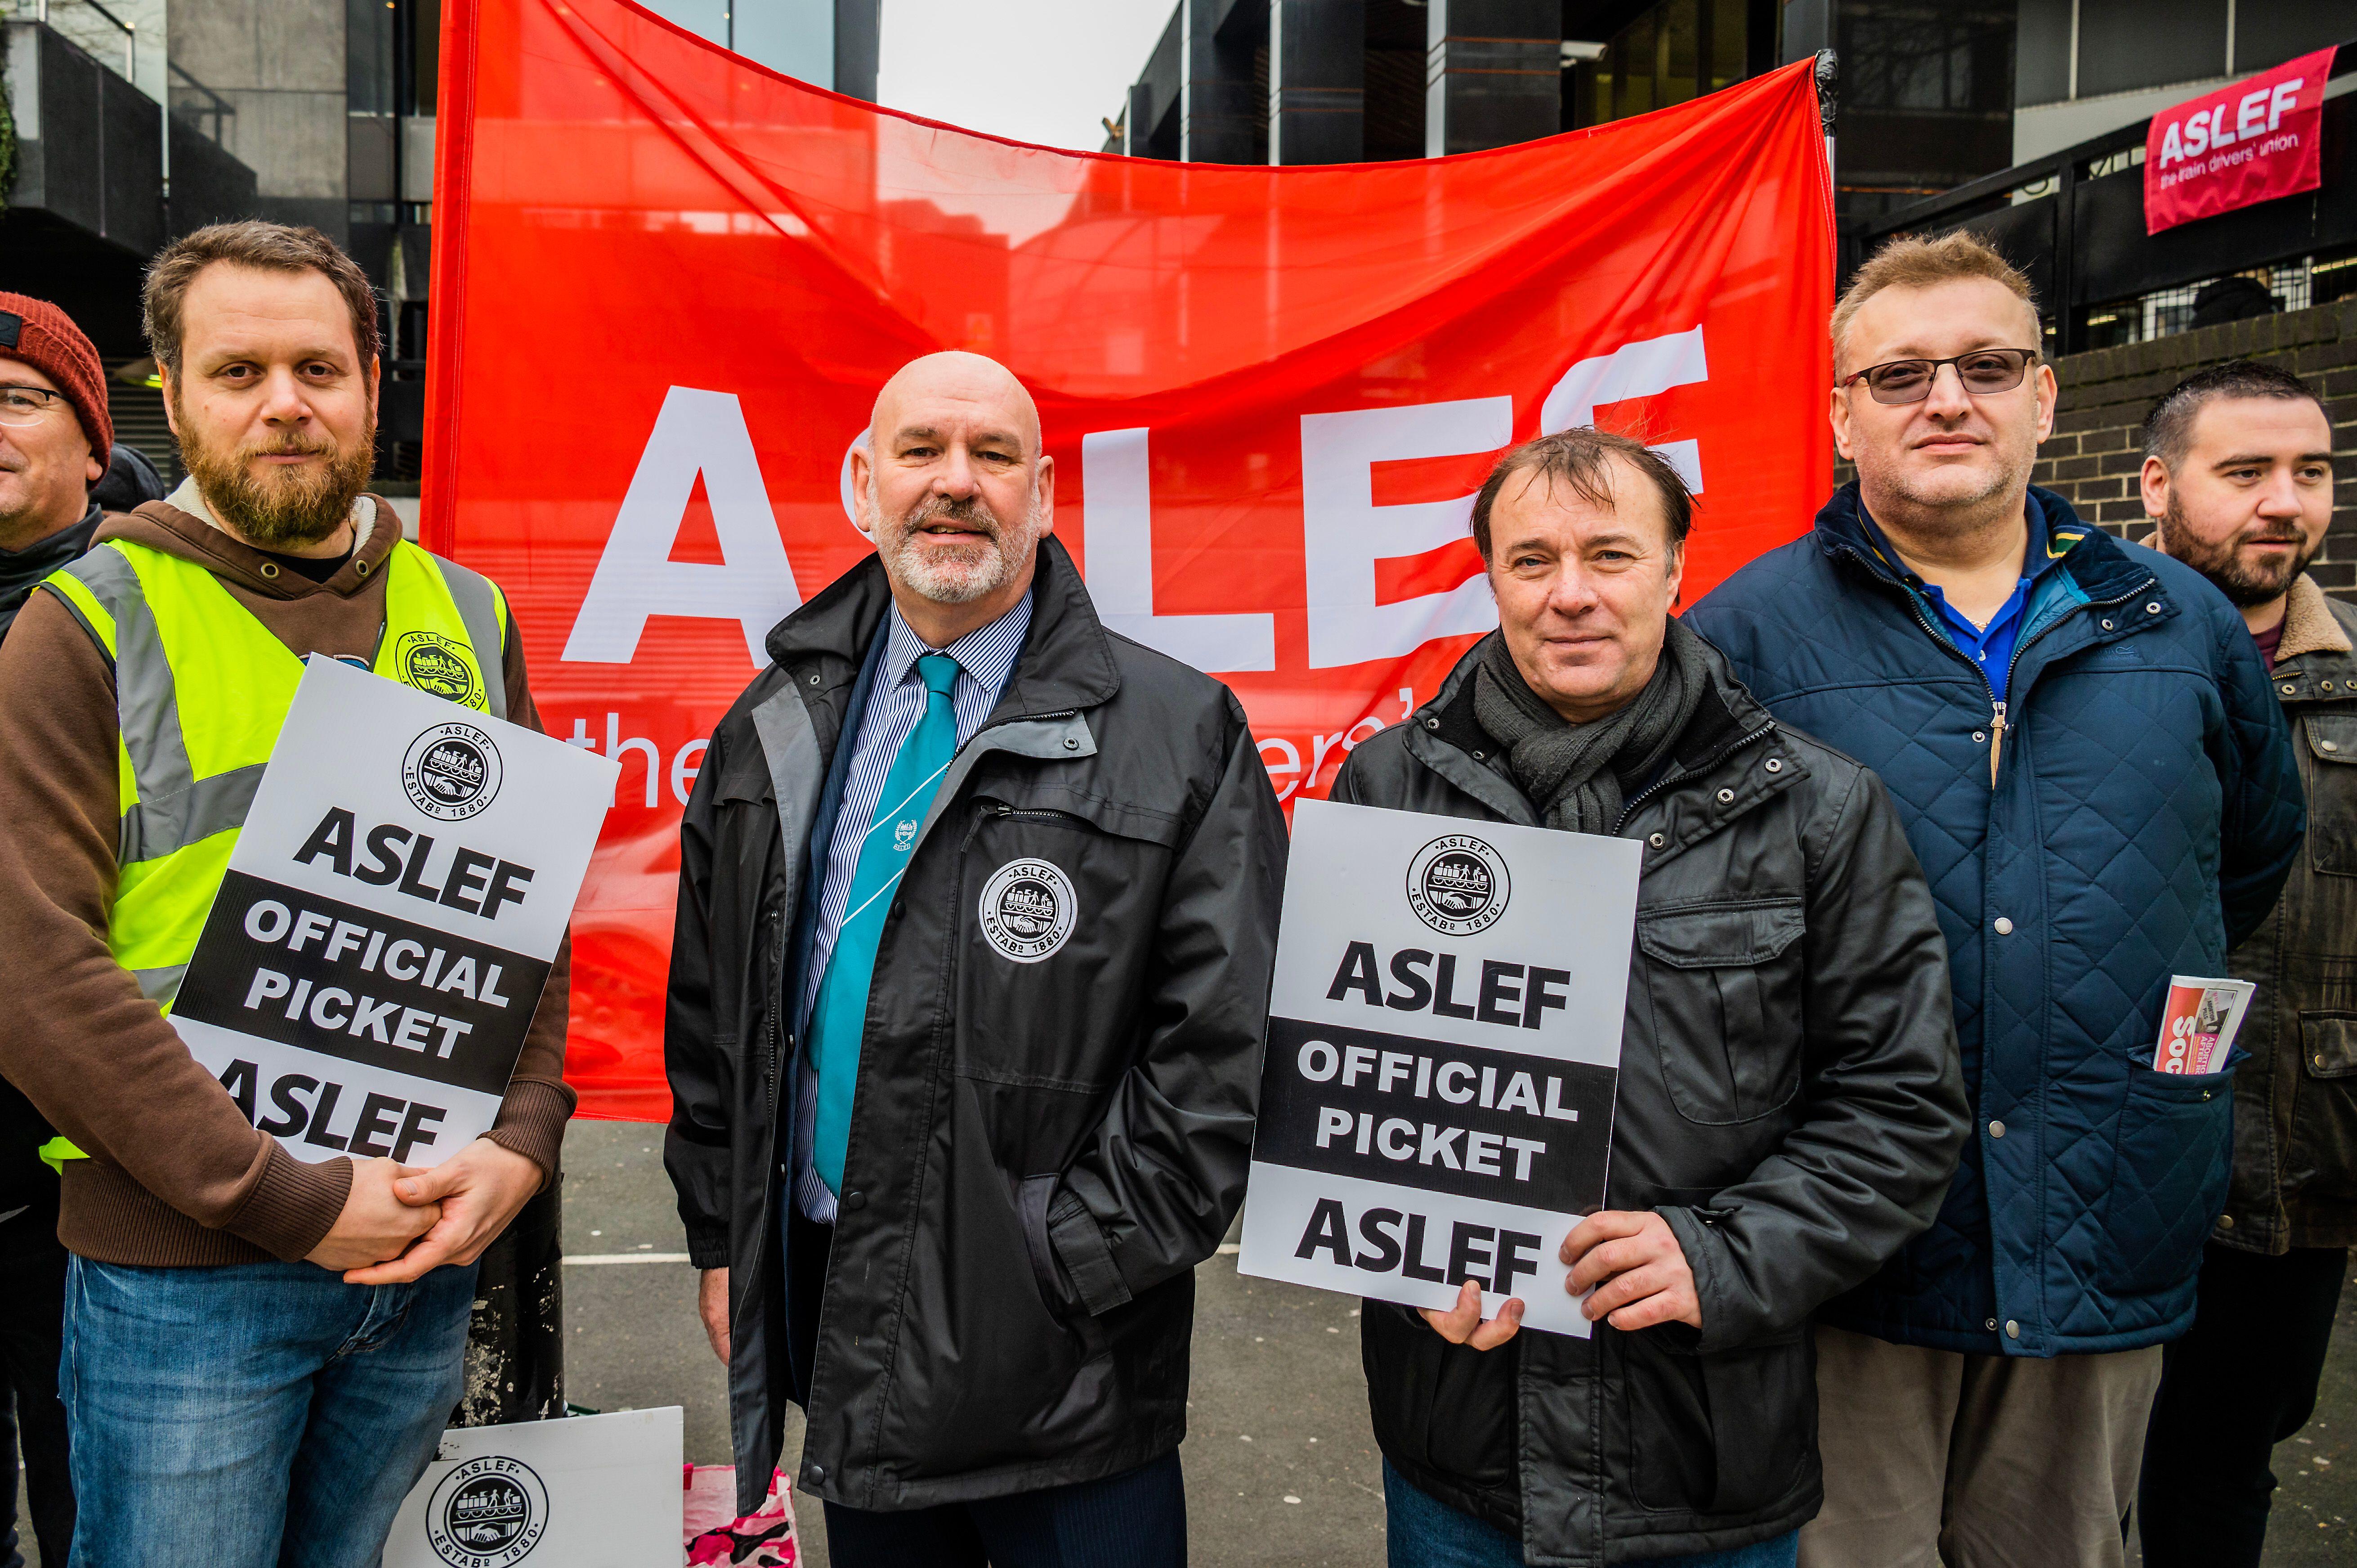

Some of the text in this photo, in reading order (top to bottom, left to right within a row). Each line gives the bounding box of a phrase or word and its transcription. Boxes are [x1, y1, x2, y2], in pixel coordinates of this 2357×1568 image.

[2159, 77, 2305, 170] ASLEF
[2259, 133, 2299, 157] union
[560, 323, 1708, 673] ALEF
[411, 634, 452, 648] ASLEF
[444, 726, 489, 747] ASLEF
[451, 799, 484, 817] 1880
[1439, 838, 1488, 853] ASLEF
[292, 806, 536, 920] ASLEF
[1013, 867, 1056, 882] ASLEF
[1466, 907, 1498, 930] 1880
[244, 900, 510, 1008] OFFICIAL
[1033, 931, 1060, 953] 1880
[1325, 940, 1571, 1030] ASLEF
[244, 967, 474, 1060] PICKET
[2197, 1036, 2208, 1063] AFTER
[1297, 1040, 1579, 1121] OFFICIAL
[219, 1058, 447, 1164] ASLEF
[1315, 1106, 1546, 1182] PICKET
[1293, 1197, 1542, 1296] ASLEF
[461, 1460, 517, 1479] ASLEF
[503, 1529, 538, 1562] 1880
